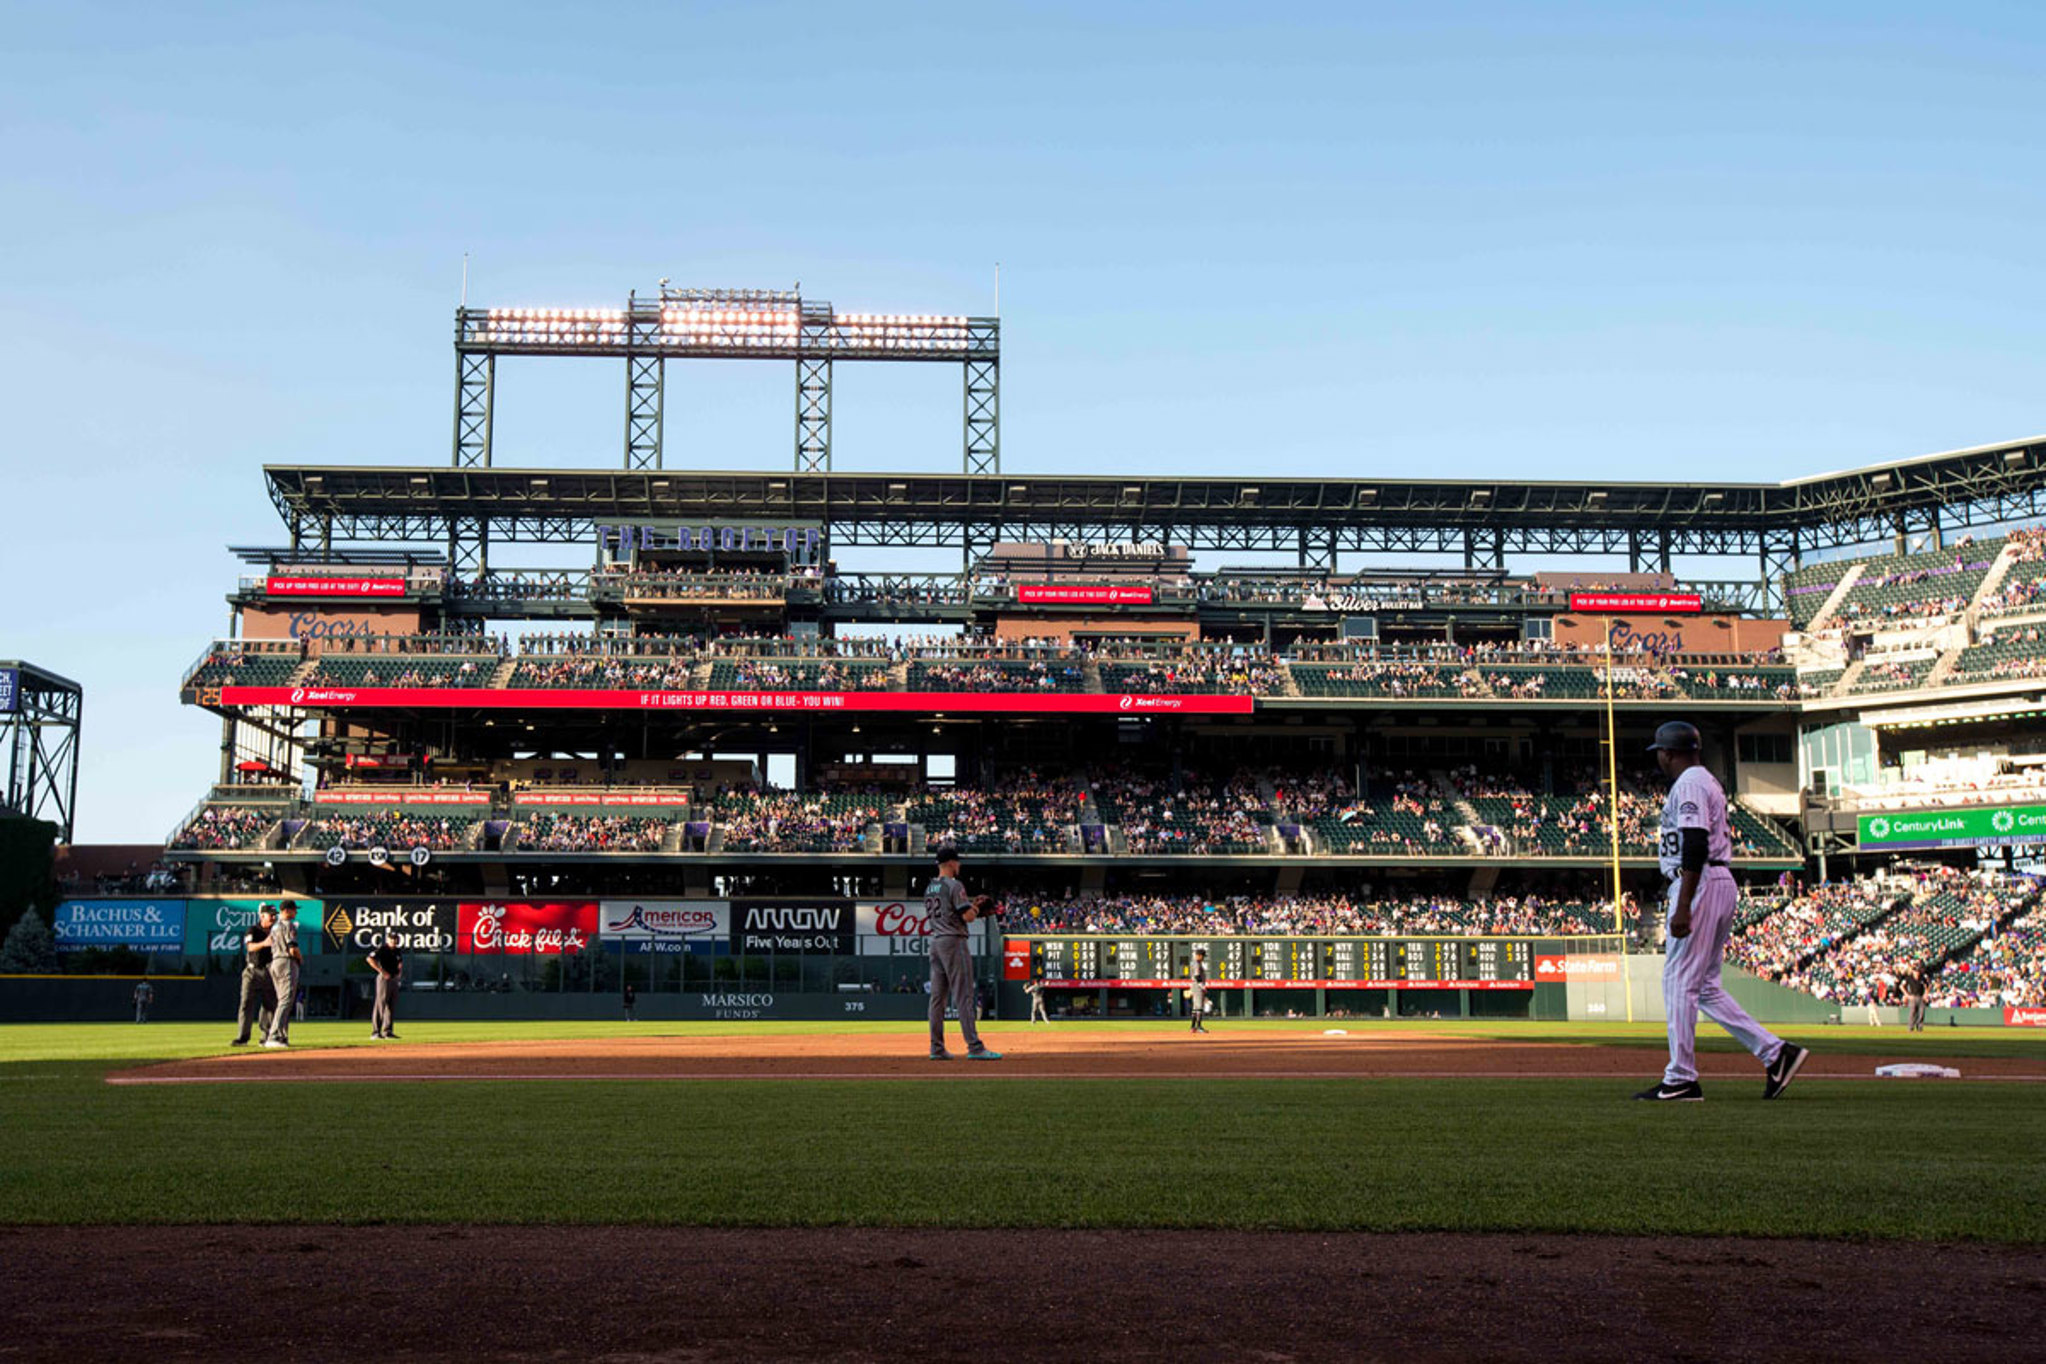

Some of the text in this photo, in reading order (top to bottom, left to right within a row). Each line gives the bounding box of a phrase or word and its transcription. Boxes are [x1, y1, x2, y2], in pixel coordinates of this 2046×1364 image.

[598, 526, 821, 552] THE ROOFTOP
[1091, 542, 1119, 555] JACK
[1330, 593, 1379, 611] Silver
[289, 611, 369, 638] Coors
[641, 695, 648, 704] IF
[651, 695, 660, 704] IT
[663, 695, 692, 705] LIGHTS
[695, 695, 706, 705] UP
[731, 695, 758, 706] GREEN
[761, 696, 772, 706] OR
[804, 696, 821, 706] YOU
[1893, 818, 1965, 832] CenturyLink
[1661, 832, 1679, 856] 39
[415, 852, 427, 862] 17
[70, 904, 164, 922] BACHUS &
[355, 904, 436, 927] Bank of
[925, 898, 941, 918] 22
[744, 908, 840, 930] ARROW
[874, 902, 934, 936] Coo
[54, 920, 180, 938] SCHANKER LLC
[746, 936, 772, 949] Five
[891, 937, 931, 954] LIGH
[1048, 951, 1060, 960] PIT
[1120, 962, 1136, 971] LAD
[702, 993, 774, 1007] MARSICO
[845, 1002, 865, 1012] 375
[716, 1009, 759, 1019] FUNDS
